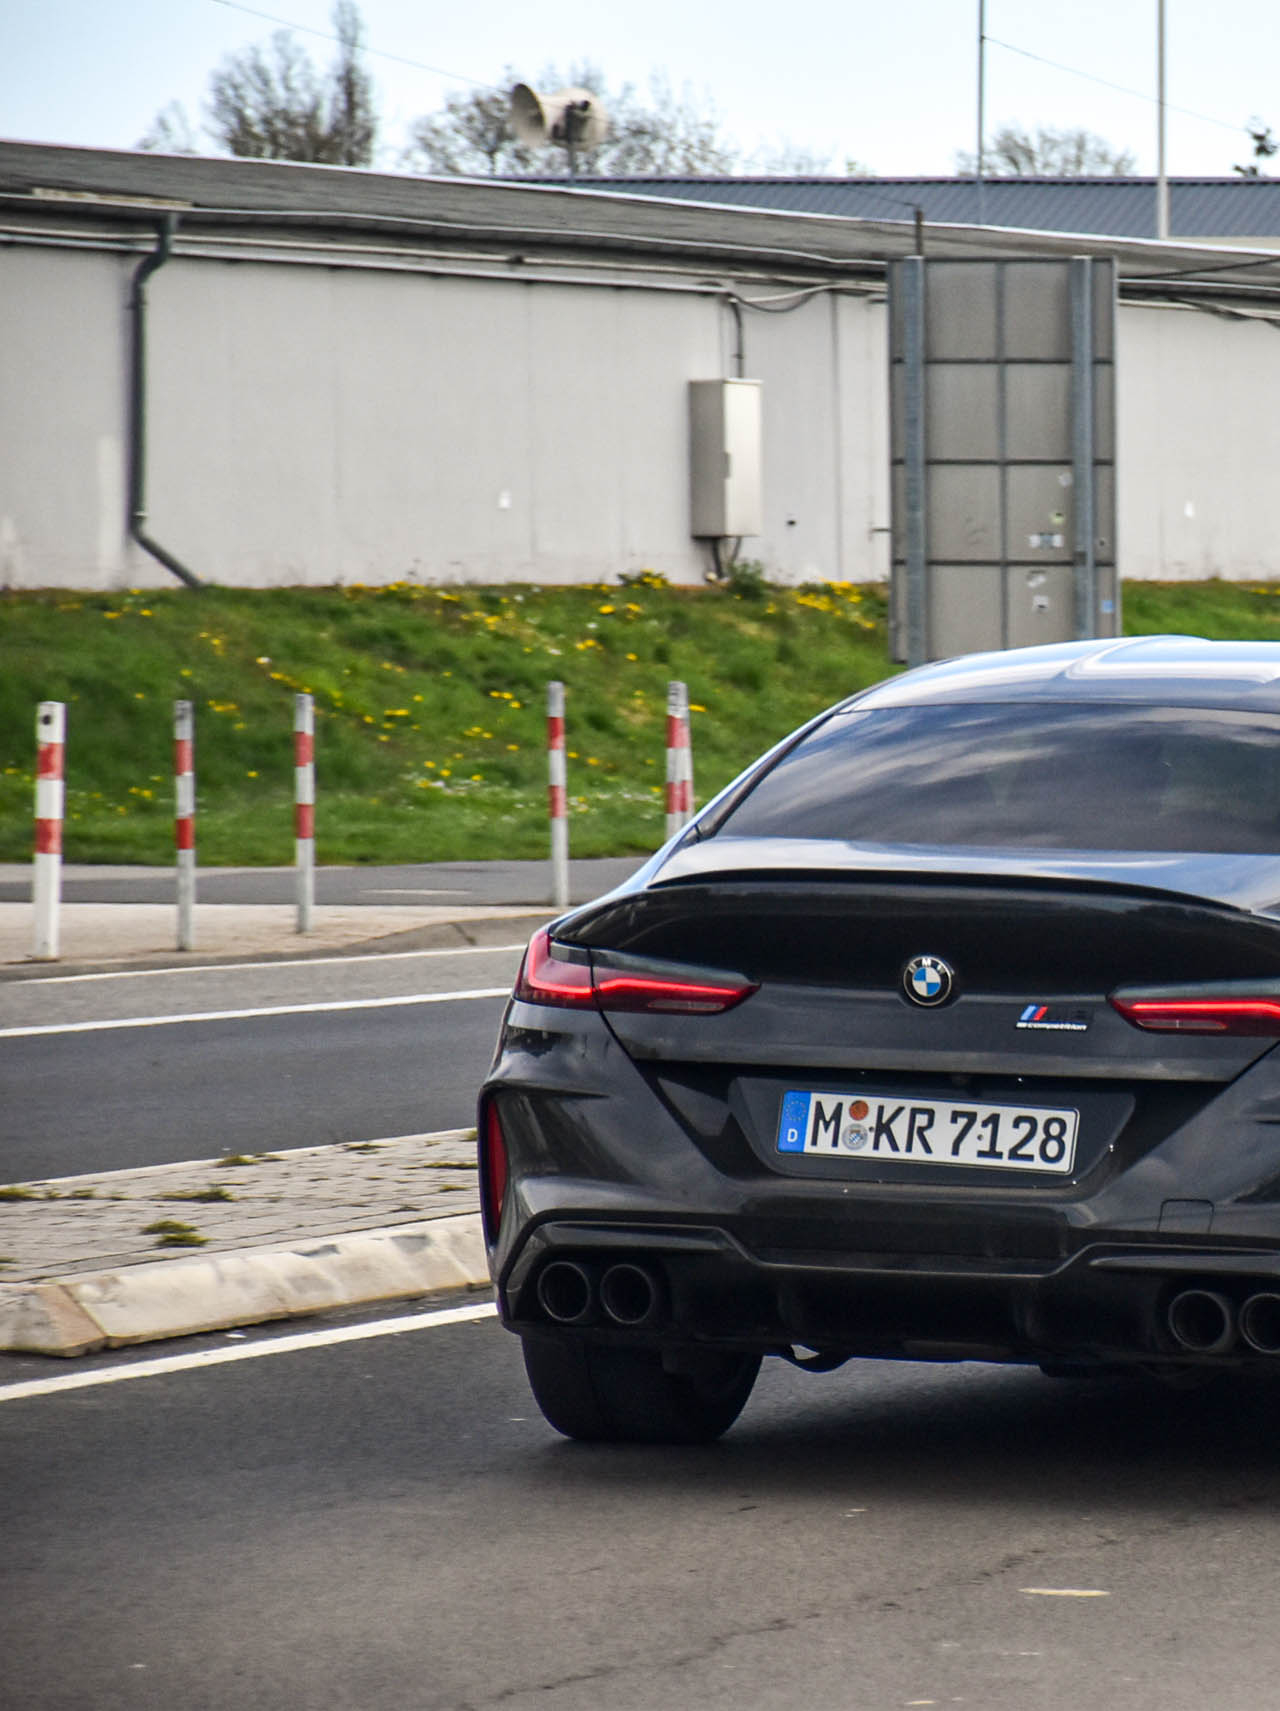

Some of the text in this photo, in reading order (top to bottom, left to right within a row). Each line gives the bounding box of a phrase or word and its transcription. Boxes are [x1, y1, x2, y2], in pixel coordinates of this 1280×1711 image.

[786, 1128, 798, 1143] D
[810, 1101, 1067, 1164] M KR 7128
